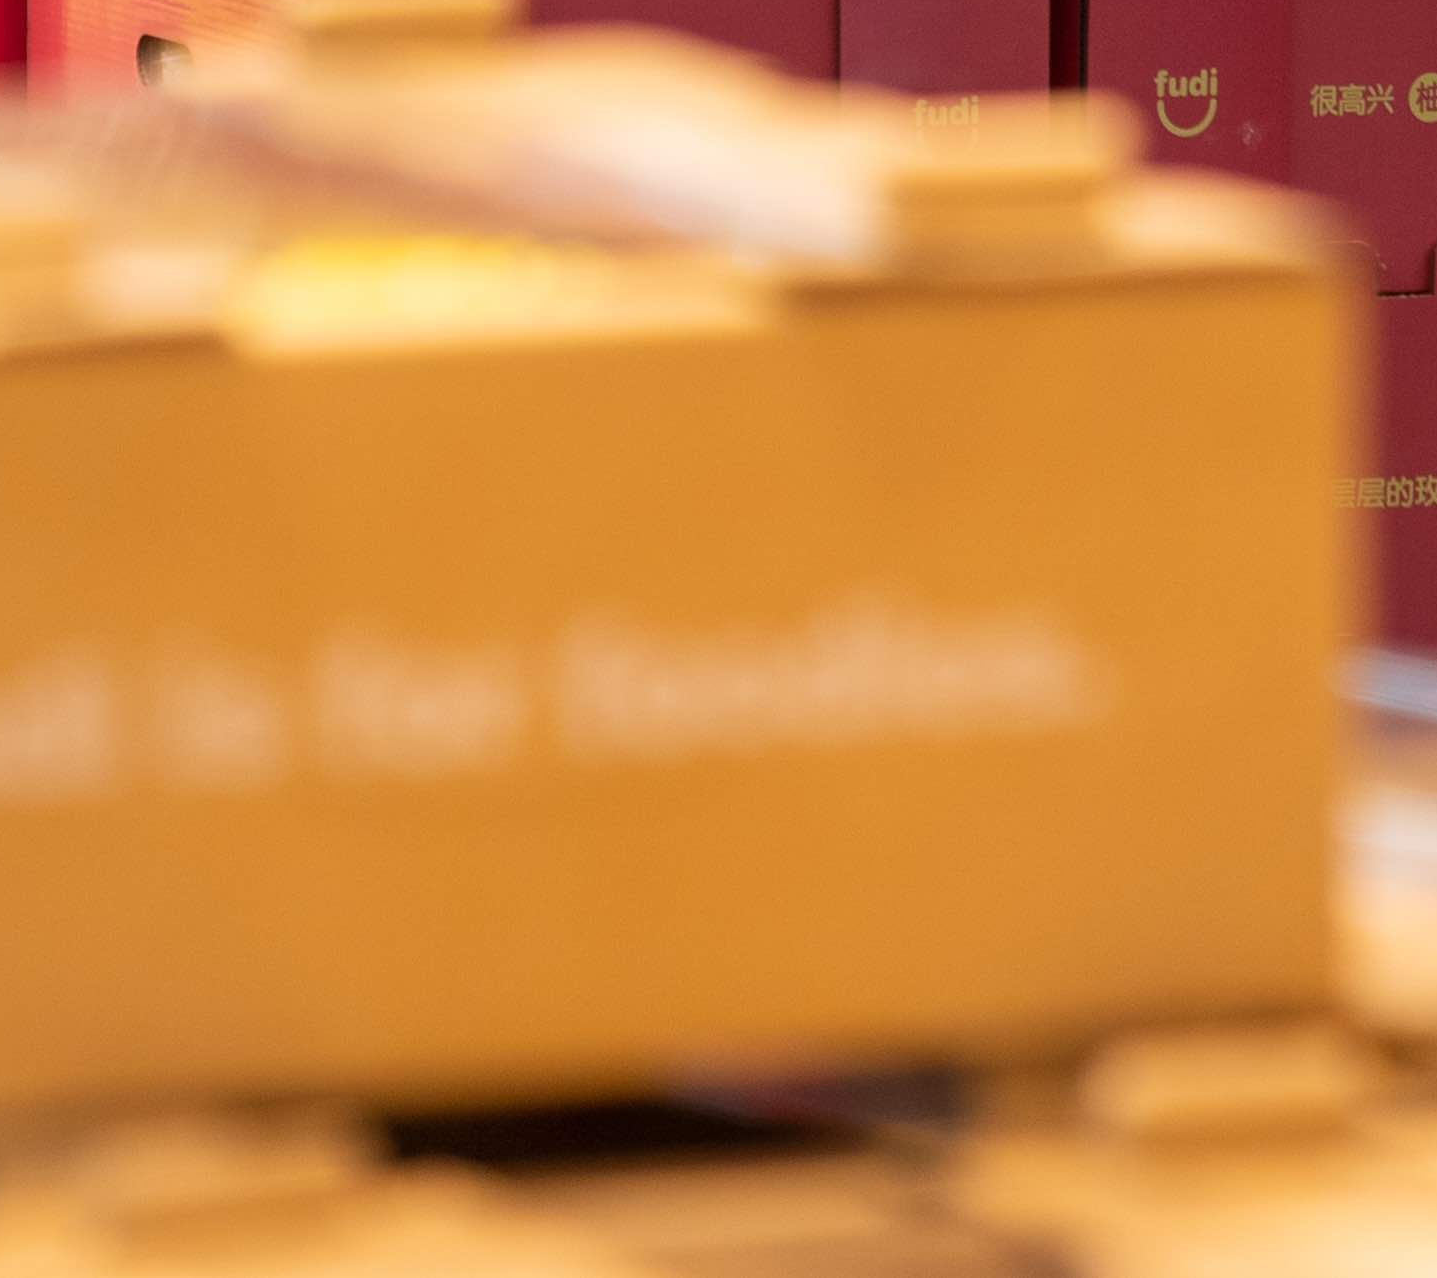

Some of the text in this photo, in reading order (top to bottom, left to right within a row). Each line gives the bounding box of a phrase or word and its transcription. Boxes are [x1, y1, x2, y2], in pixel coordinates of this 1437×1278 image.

[1154, 68, 1218, 99] fudi
[1310, 84, 1394, 118] 很高兴
